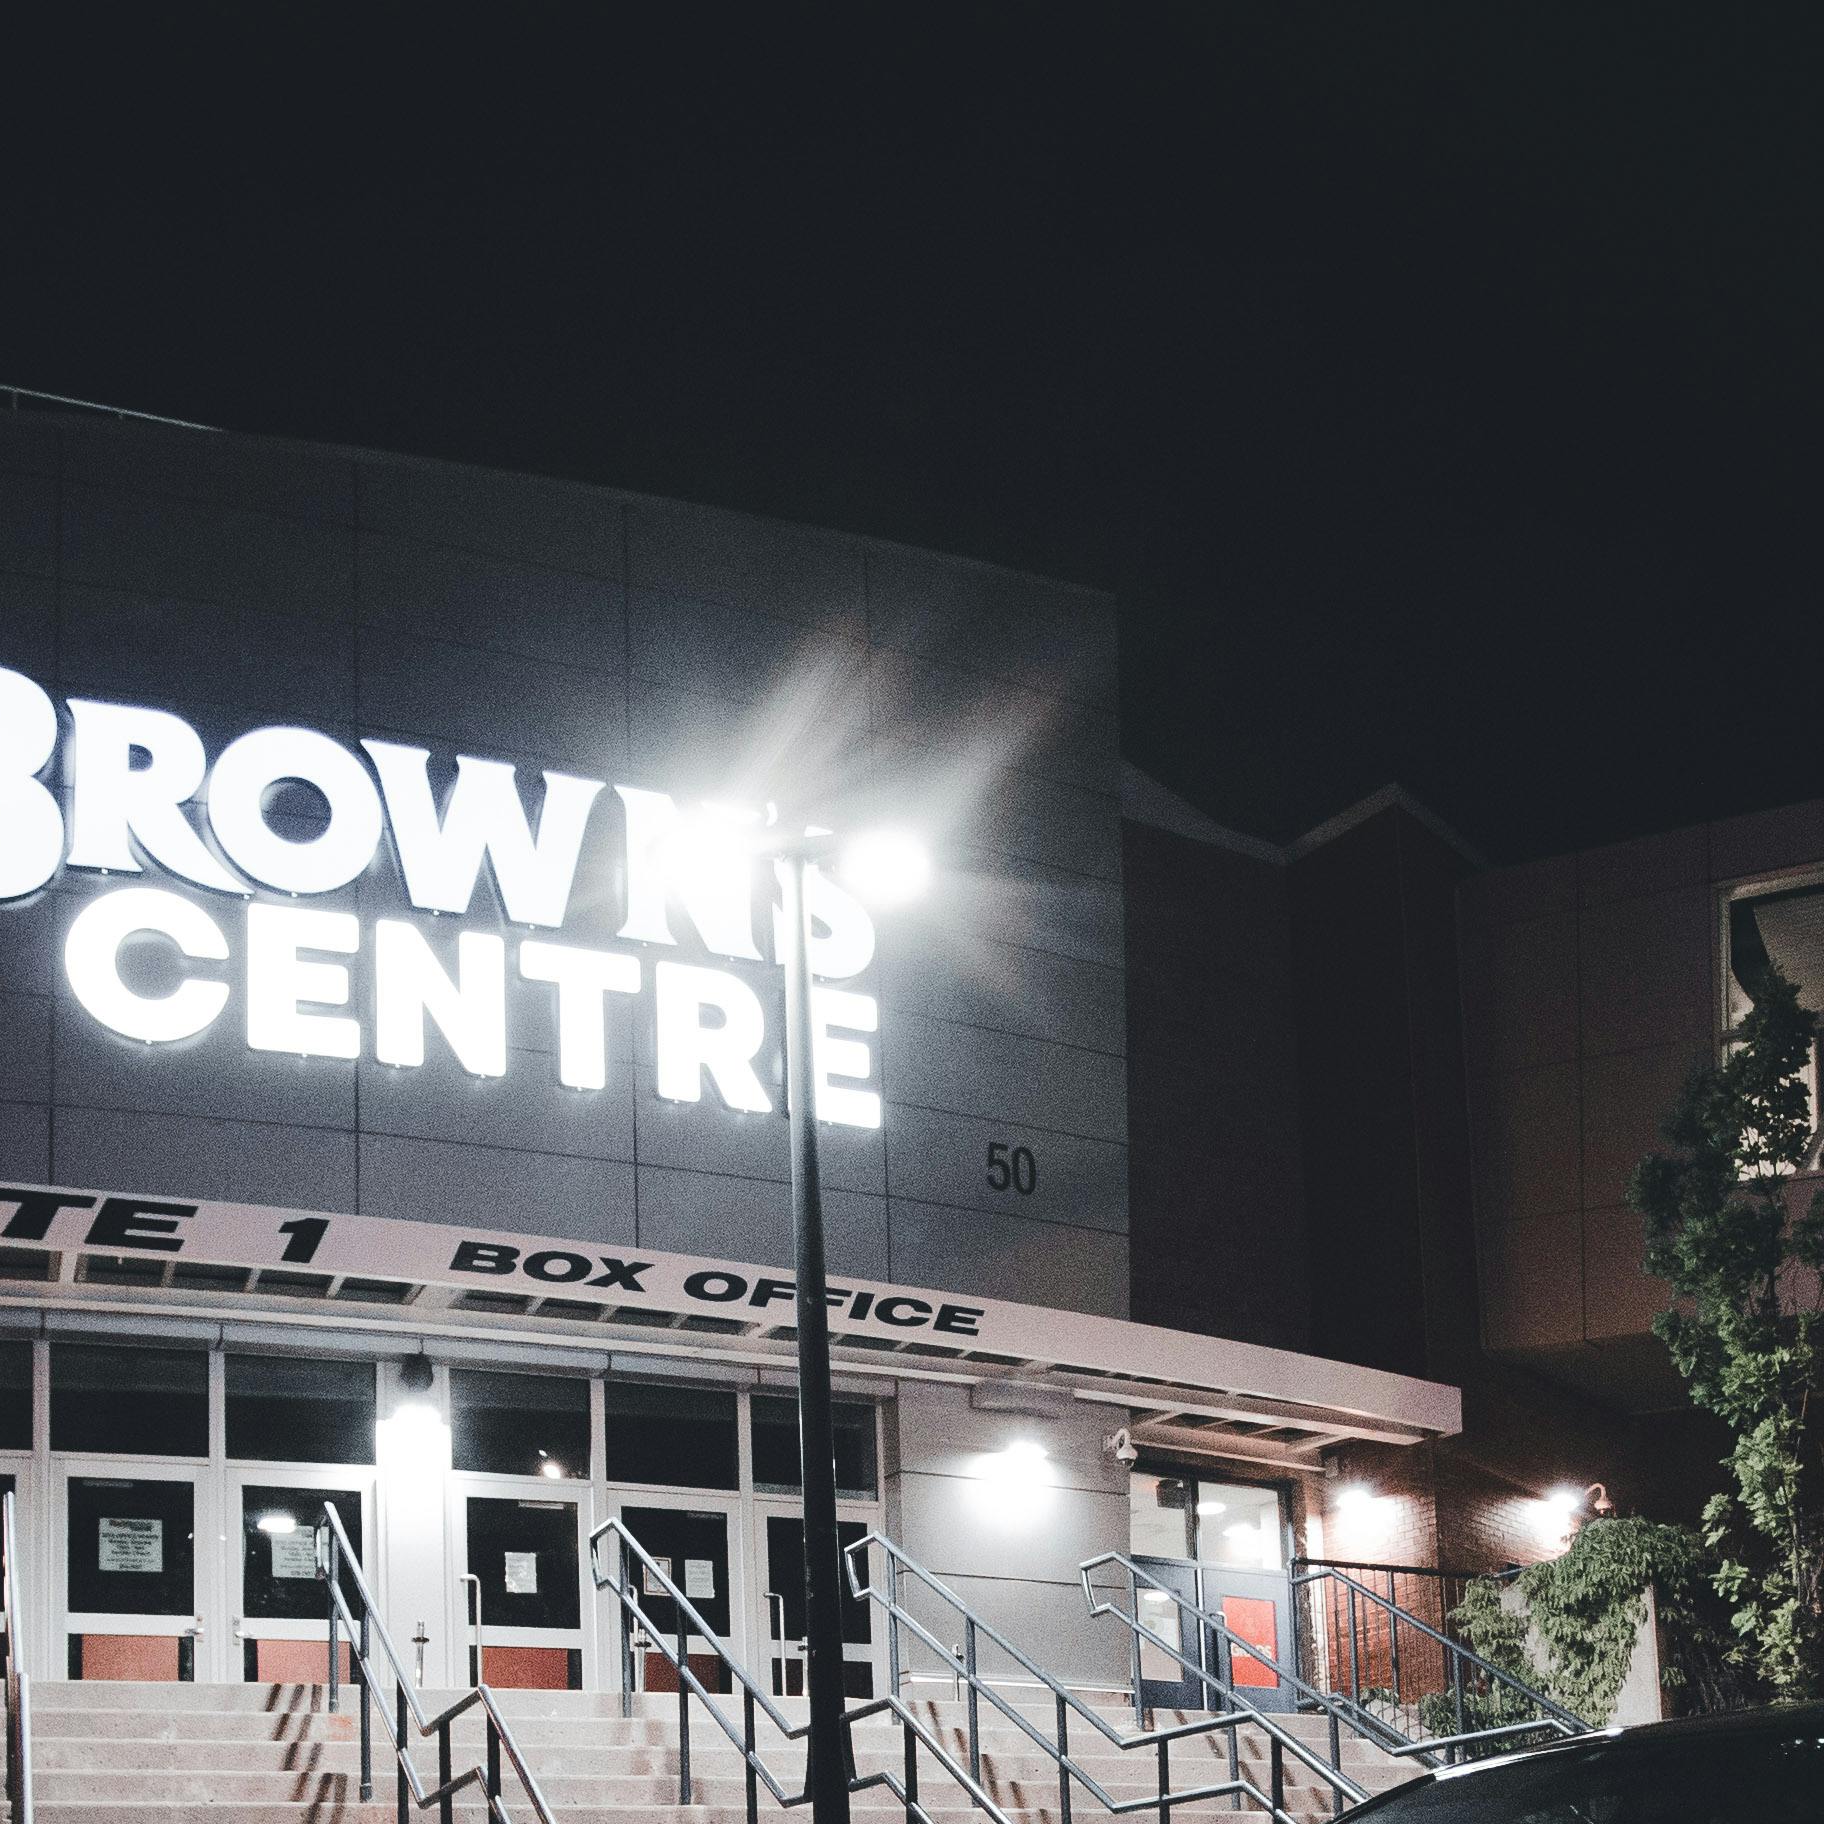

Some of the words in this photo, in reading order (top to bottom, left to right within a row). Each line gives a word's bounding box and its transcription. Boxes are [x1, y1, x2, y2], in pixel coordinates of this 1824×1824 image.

[64, 887, 881, 1130] CENTRE
[987, 1142, 1037, 1196] 50
[278, 1217, 330, 1264] 1
[449, 1240, 656, 1293] BOX
